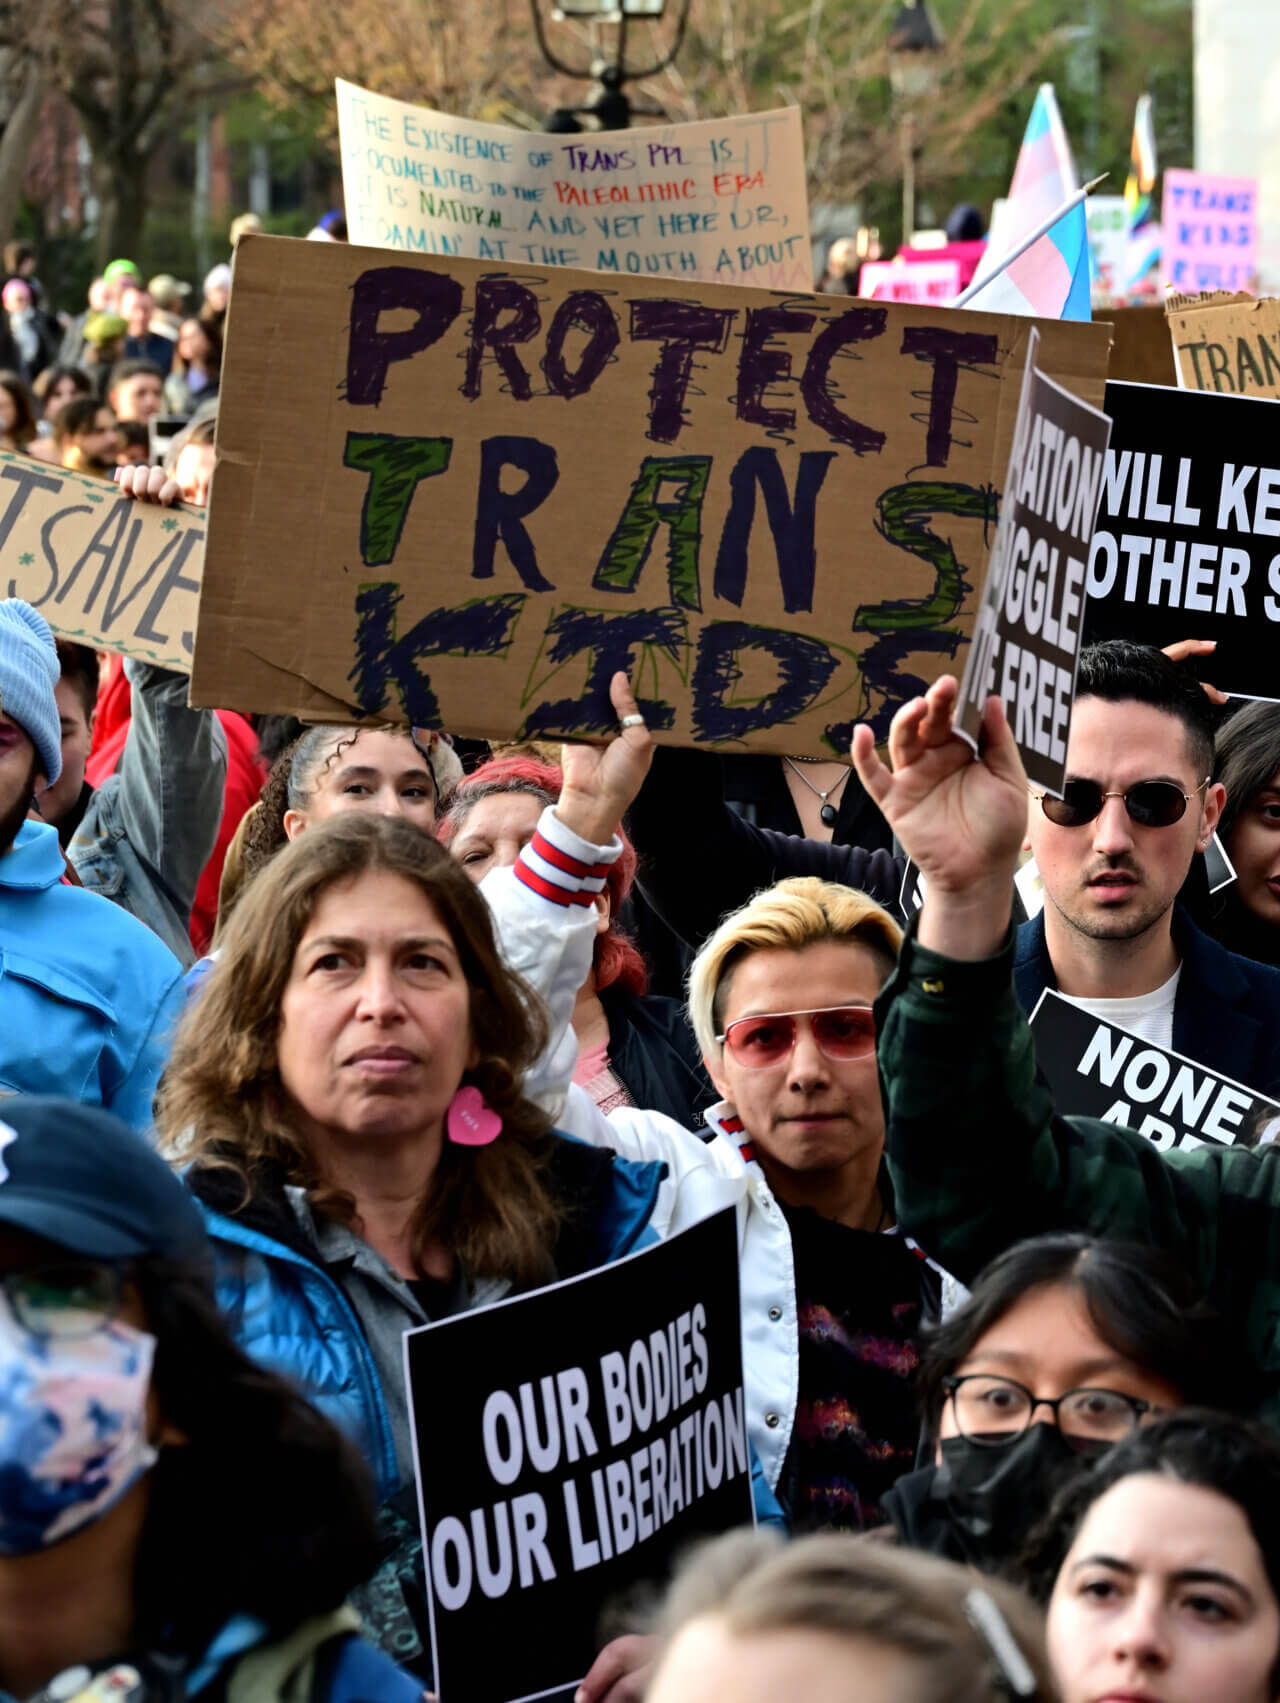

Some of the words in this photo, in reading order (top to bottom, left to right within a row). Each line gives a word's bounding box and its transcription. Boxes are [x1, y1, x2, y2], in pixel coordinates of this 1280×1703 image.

[403, 115, 513, 163] EXISTENCE
[528, 151, 552, 168] OF
[562, 143, 637, 173] TRANS
[647, 143, 690, 168] PPL
[709, 137, 733, 162] IS
[512, 186, 545, 203] THE
[554, 178, 697, 207] PALEOLITHIC
[713, 168, 765, 197] ERA
[387, 184, 409, 209] IS
[528, 207, 586, 236] AND
[593, 213, 645, 240] YET
[658, 211, 719, 238] HERE
[478, 236, 509, 260] AT
[520, 243, 580, 266] THE
[596, 248, 697, 274] MOUTH
[715, 235, 804, 273] ABOUT
[345, 267, 1001, 468] PROTECT
[342, 430, 1001, 631] TRANS
[1102, 449, 1202, 527] WILL
[7, 497, 206, 655] SAVE
[1086, 530, 1252, 617] OTHER
[348, 580, 970, 757] KIDS
[1001, 640, 1073, 766] FREE
[1076, 1024, 1254, 1146] NONE
[482, 1366, 598, 1486] OUR
[600, 1303, 708, 1447] BODIES
[430, 1491, 558, 1611] OUR
[562, 1386, 748, 1572] LIBERATION
